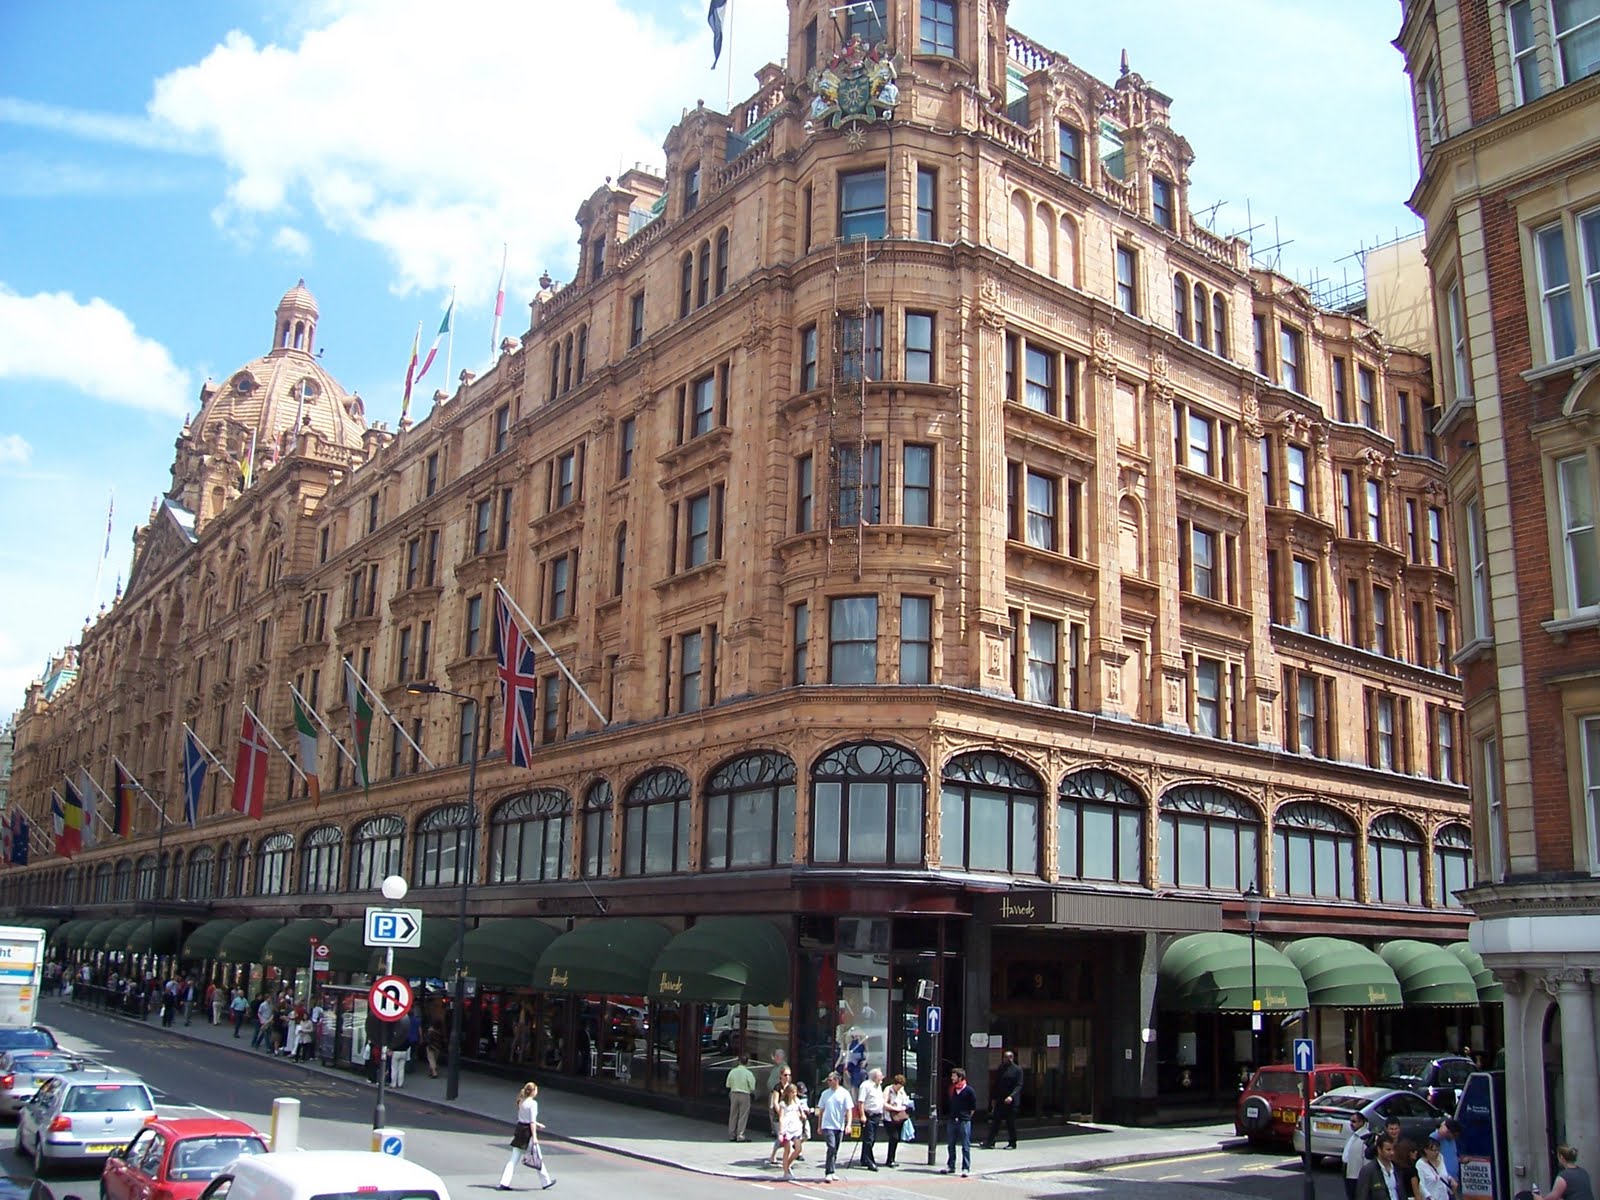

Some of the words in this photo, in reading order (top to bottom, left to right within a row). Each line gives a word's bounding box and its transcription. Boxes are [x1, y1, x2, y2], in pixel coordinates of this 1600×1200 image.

[1000, 897, 1035, 918] Harrods
[378, 918, 393, 936] P
[659, 972, 684, 994] Harrods
